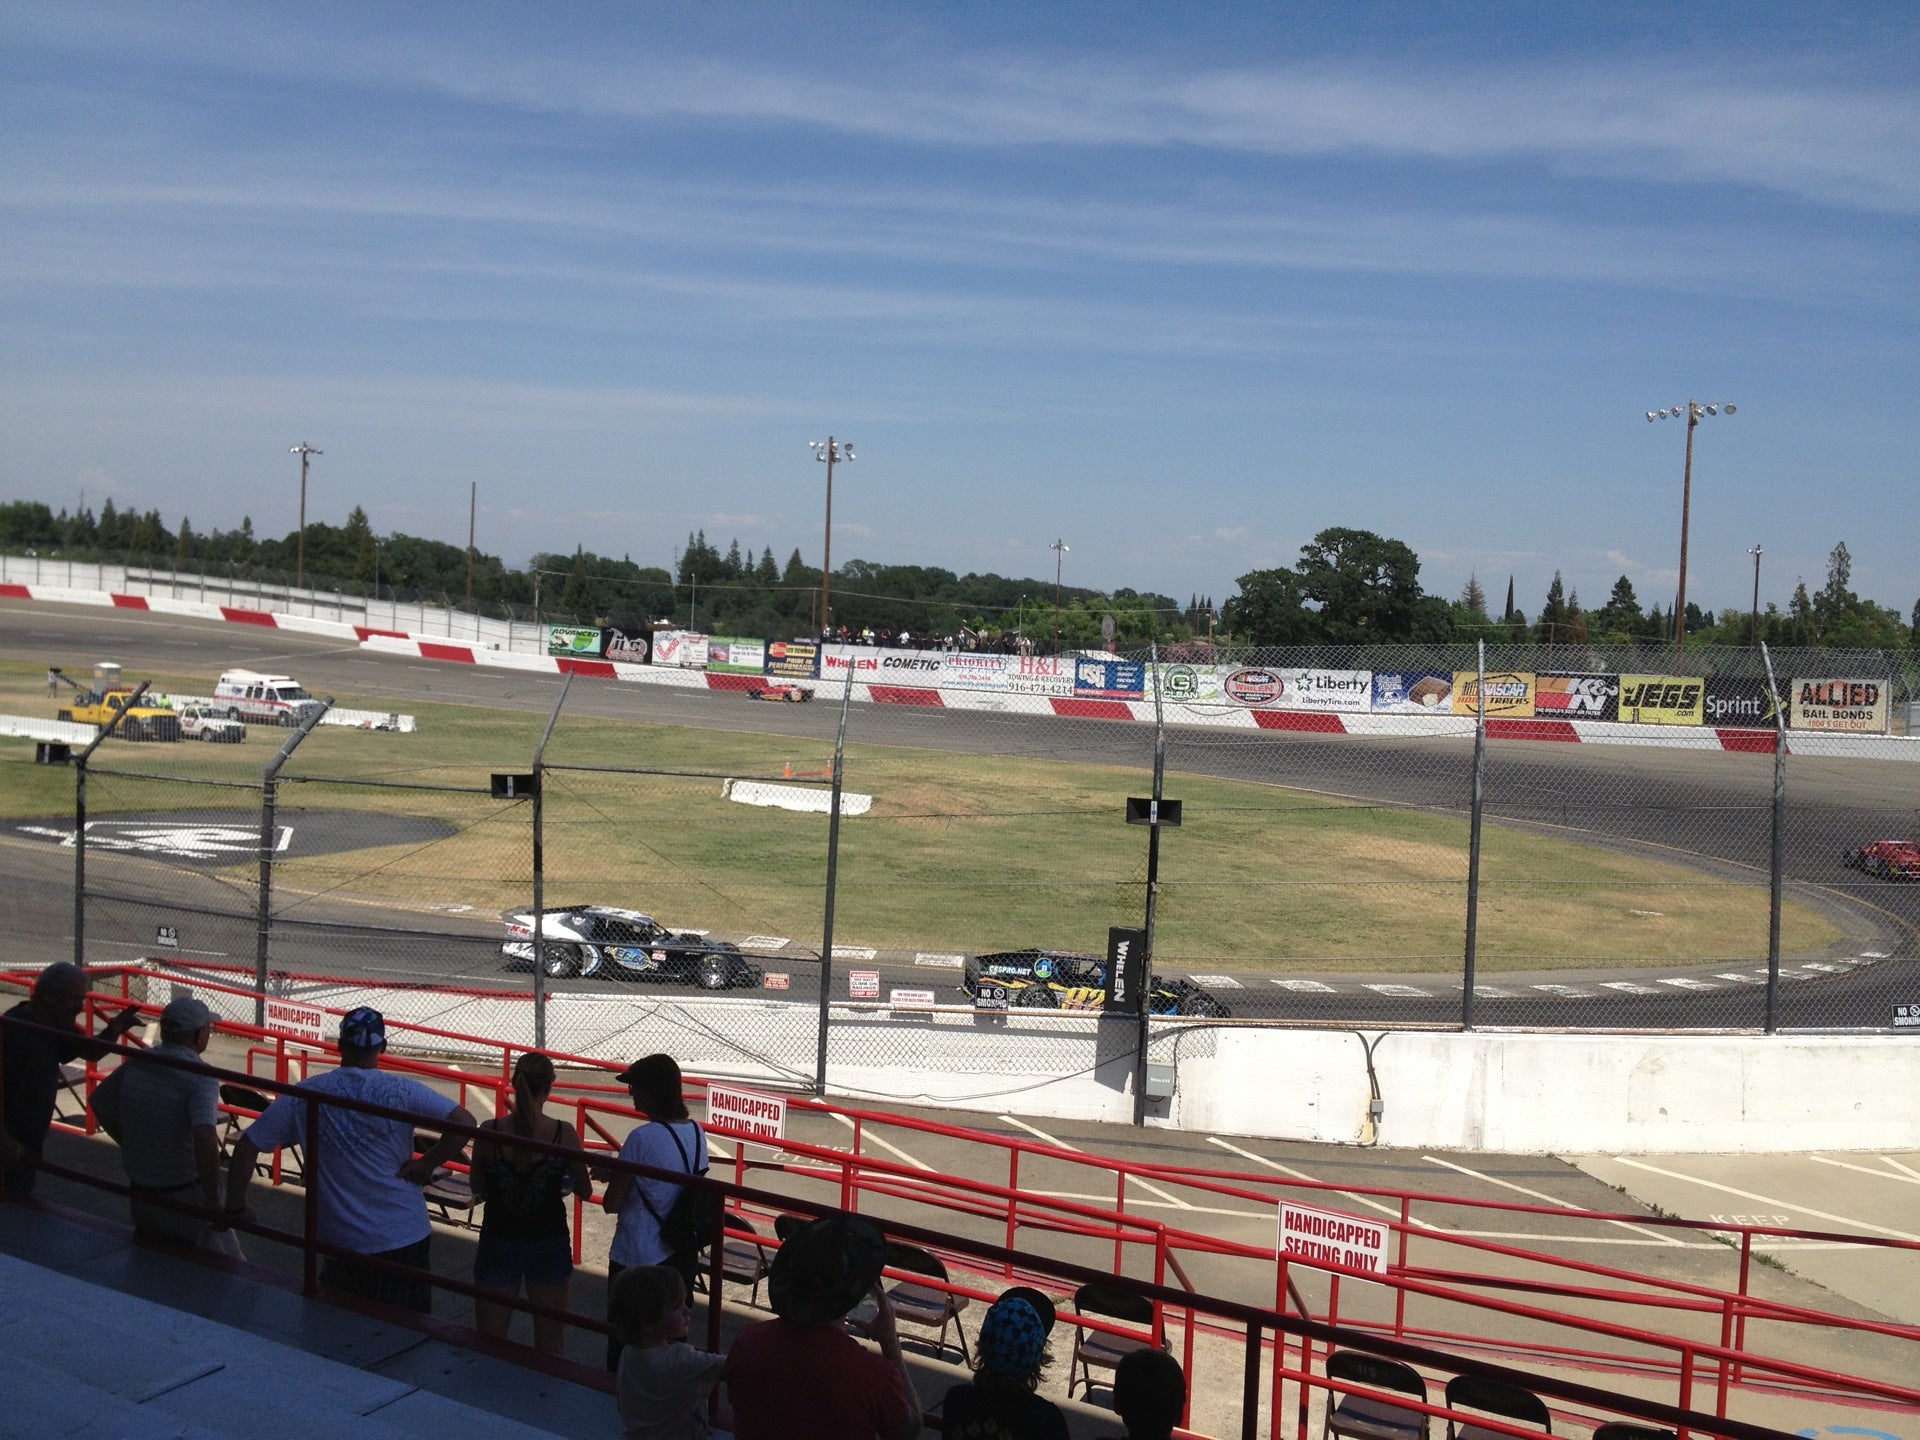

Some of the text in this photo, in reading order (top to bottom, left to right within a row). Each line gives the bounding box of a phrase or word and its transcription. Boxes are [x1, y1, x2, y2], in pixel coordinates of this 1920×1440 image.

[551, 628, 599, 638] ADVANCED
[883, 657, 940, 671] COMETIC
[948, 657, 1002, 669] PRIORITY
[1019, 656, 1063, 676] H&L
[1079, 664, 1105, 688] USG
[1008, 682, 1073, 695] 916-474-4214
[1234, 684, 1273, 692] WHELEN
[1316, 676, 1369, 694] Liberty
[1483, 683, 1525, 697] NASCAR
[1163, 690, 1198, 699] CLEAN
[1489, 697, 1529, 705] TRACKS
[1622, 684, 1701, 710] JEGS
[1799, 683, 1879, 707] ALLIED
[1302, 697, 1360, 706] LibertyTire.com
[1705, 695, 1761, 718] Sprint
[1803, 709, 1873, 721] BAIL BONDS
[1833, 721, 1848, 729] GET
[1114, 940, 1130, 1002] WHELEN
[981, 988, 991, 998] NO
[976, 998, 1007, 1008] SMOKING
[268, 1004, 321, 1027] HANDICAPPED
[1897, 1007, 1907, 1016] NO
[1894, 1017, 1920, 1026] SMOKIN
[712, 1092, 780, 1121] HANDICAPPED
[1709, 1214, 1790, 1227] KEEP
[1285, 1210, 1381, 1250] HANDICAPPED
[1285, 1236, 1341, 1263] SEATING
